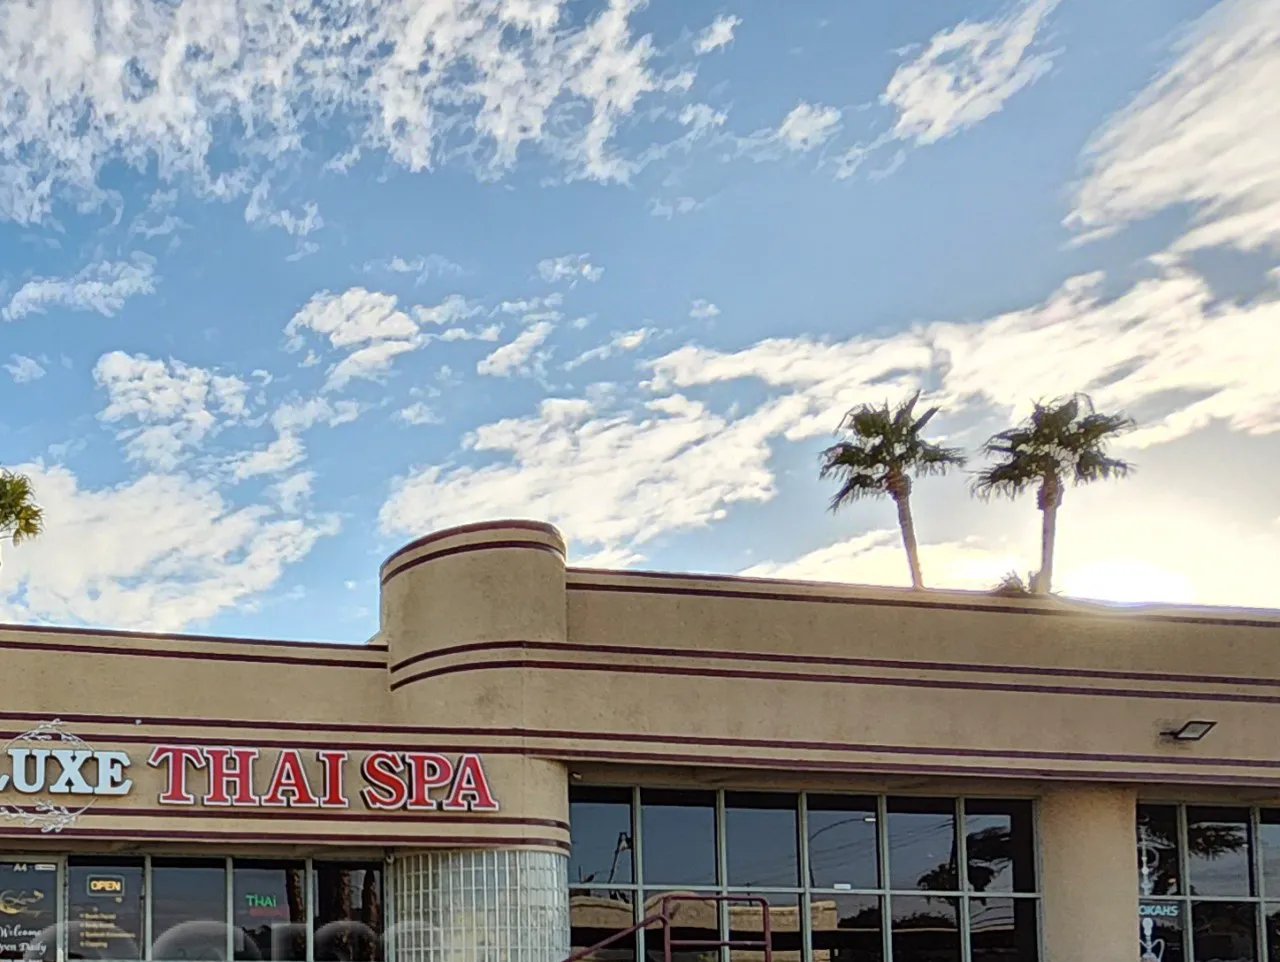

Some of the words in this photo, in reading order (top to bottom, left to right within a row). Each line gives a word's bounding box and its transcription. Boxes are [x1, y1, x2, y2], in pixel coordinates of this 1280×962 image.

[147, 744, 349, 809] THAI
[359, 750, 499, 811] SPA
[91, 880, 121, 891] OPEN
[19, 942, 47, 955] Daily
